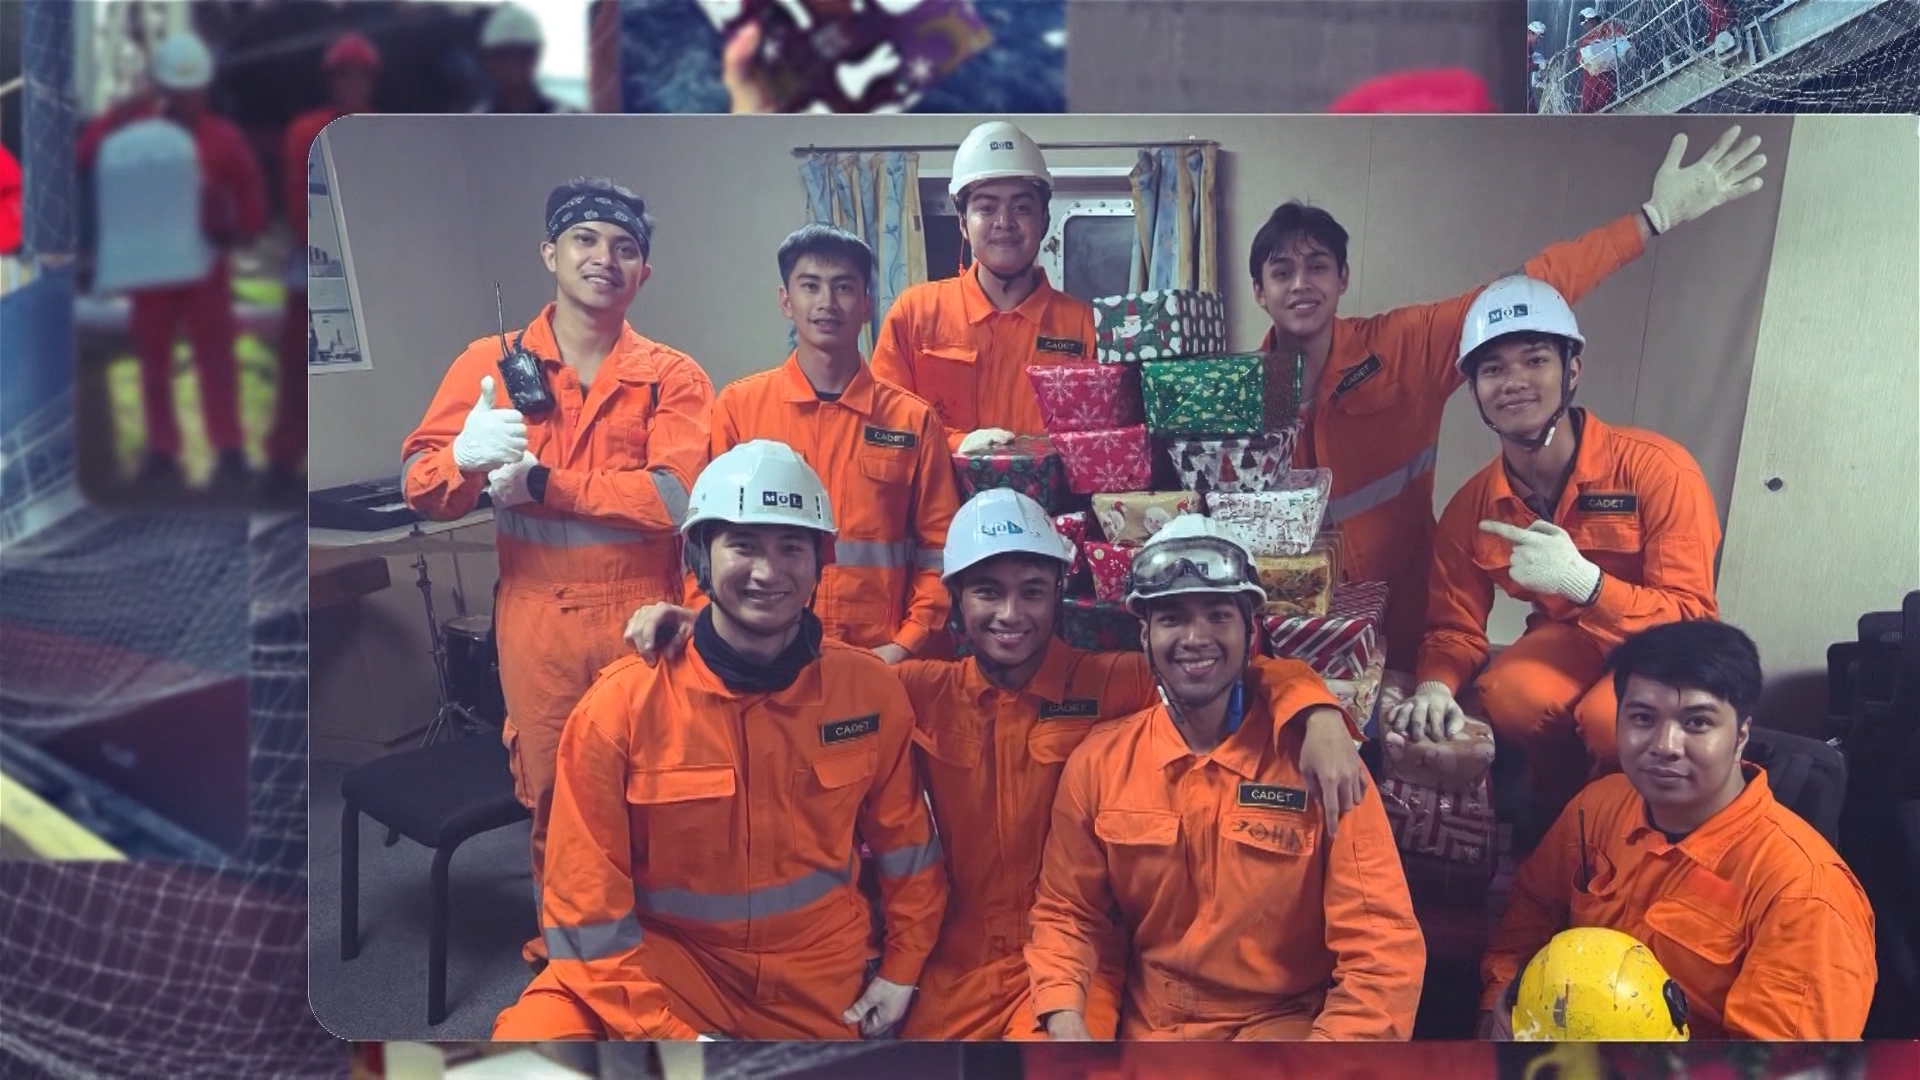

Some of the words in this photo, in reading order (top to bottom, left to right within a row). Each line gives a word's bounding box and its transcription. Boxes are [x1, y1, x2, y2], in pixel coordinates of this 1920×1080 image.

[990, 142, 1014, 151] MOL
[1489, 304, 1529, 324] MOL
[1046, 340, 1077, 351] CADET
[1343, 363, 1370, 387] CADET
[874, 431, 906, 443] CADET
[763, 491, 803, 510] MOL
[1588, 498, 1624, 509] CADET
[835, 721, 870, 736] CADET
[1251, 790, 1294, 803] CADET
